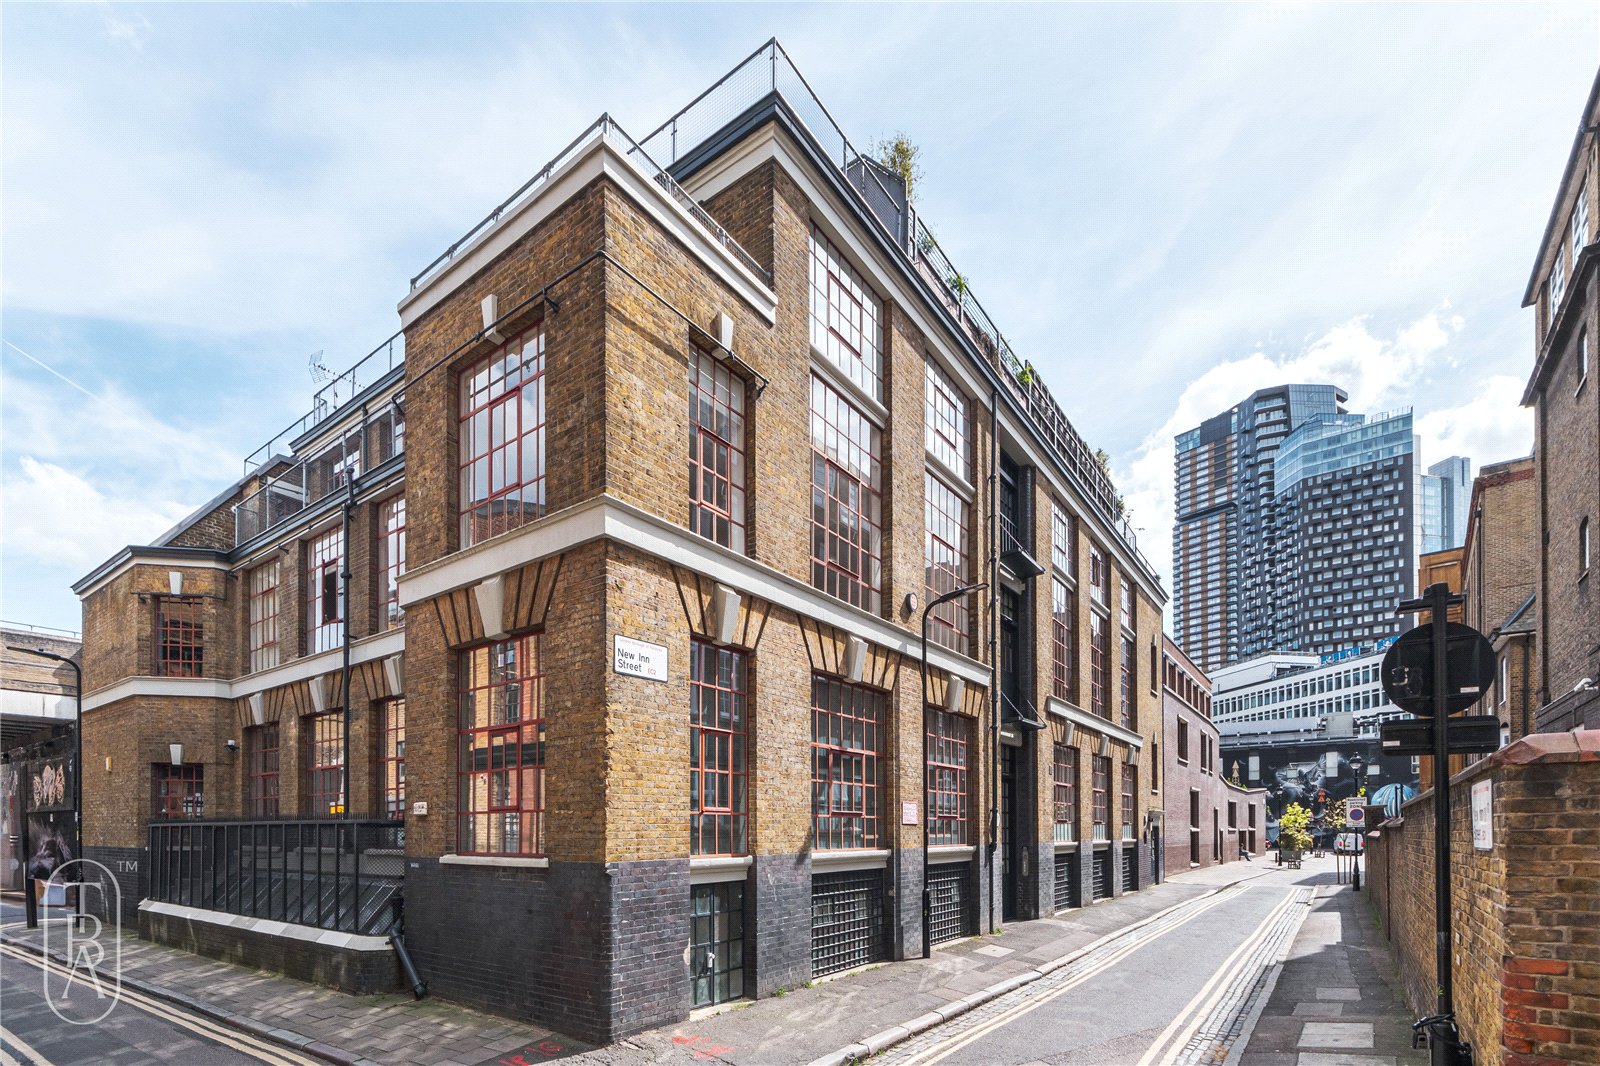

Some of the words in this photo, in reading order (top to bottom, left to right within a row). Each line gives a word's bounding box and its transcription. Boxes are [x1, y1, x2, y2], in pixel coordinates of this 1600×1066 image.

[617, 648, 635, 660] New
[638, 653, 650, 663] Inn
[617, 658, 642, 672] Street
